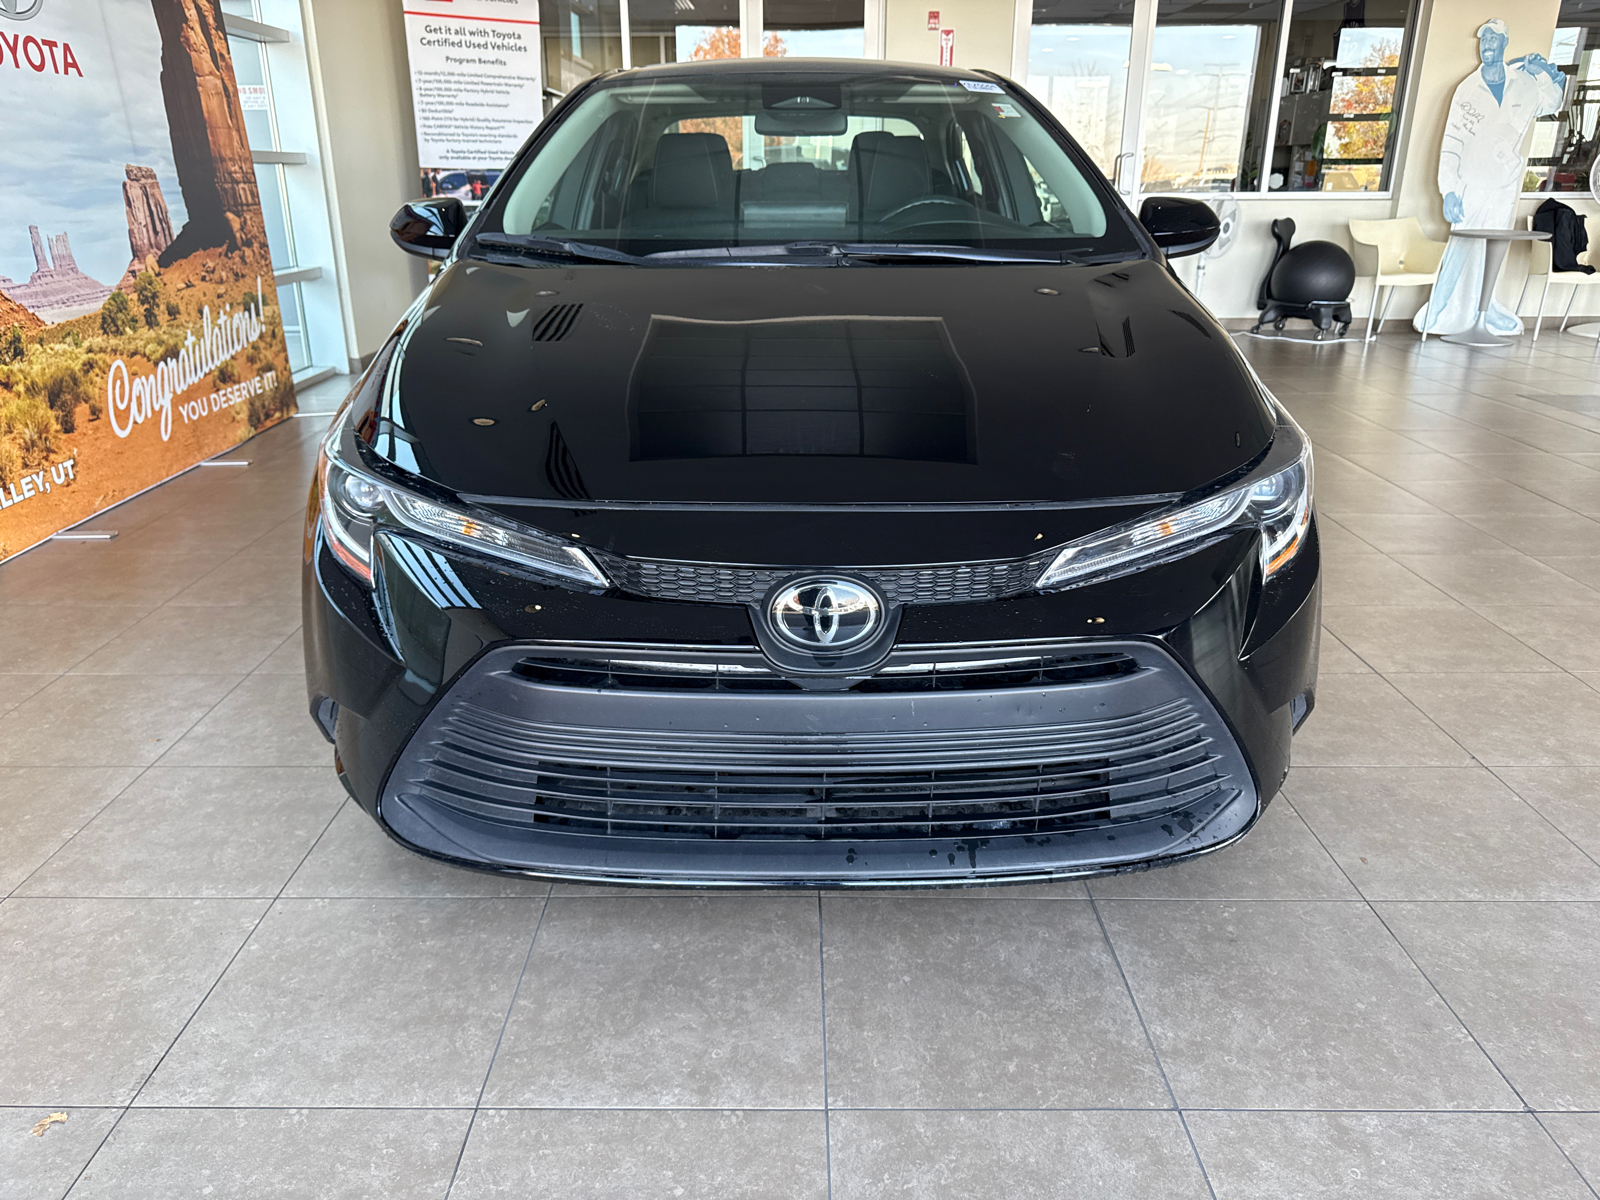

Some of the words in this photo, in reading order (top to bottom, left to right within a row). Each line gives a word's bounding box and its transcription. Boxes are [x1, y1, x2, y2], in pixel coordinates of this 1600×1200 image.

[0, 31, 84, 78] YOTA
[420, 37, 462, 48] Certified
[465, 40, 488, 50] Used
[490, 42, 528, 52] Vehicles
[424, 24, 444, 35] Get
[444, 26, 453, 36] it
[454, 26, 466, 36] all
[468, 28, 490, 38] with
[490, 30, 522, 41] Toyota
[446, 56, 477, 66] Program
[478, 58, 507, 66] Benefits
[107, 275, 267, 442] Congratulations!
[179, 397, 208, 424] YOU
[210, 376, 263, 412] DESERVE
[262, 370, 278, 391] IT!
[0, 470, 51, 511] LLEY,
[50, 458, 75, 485] UT
